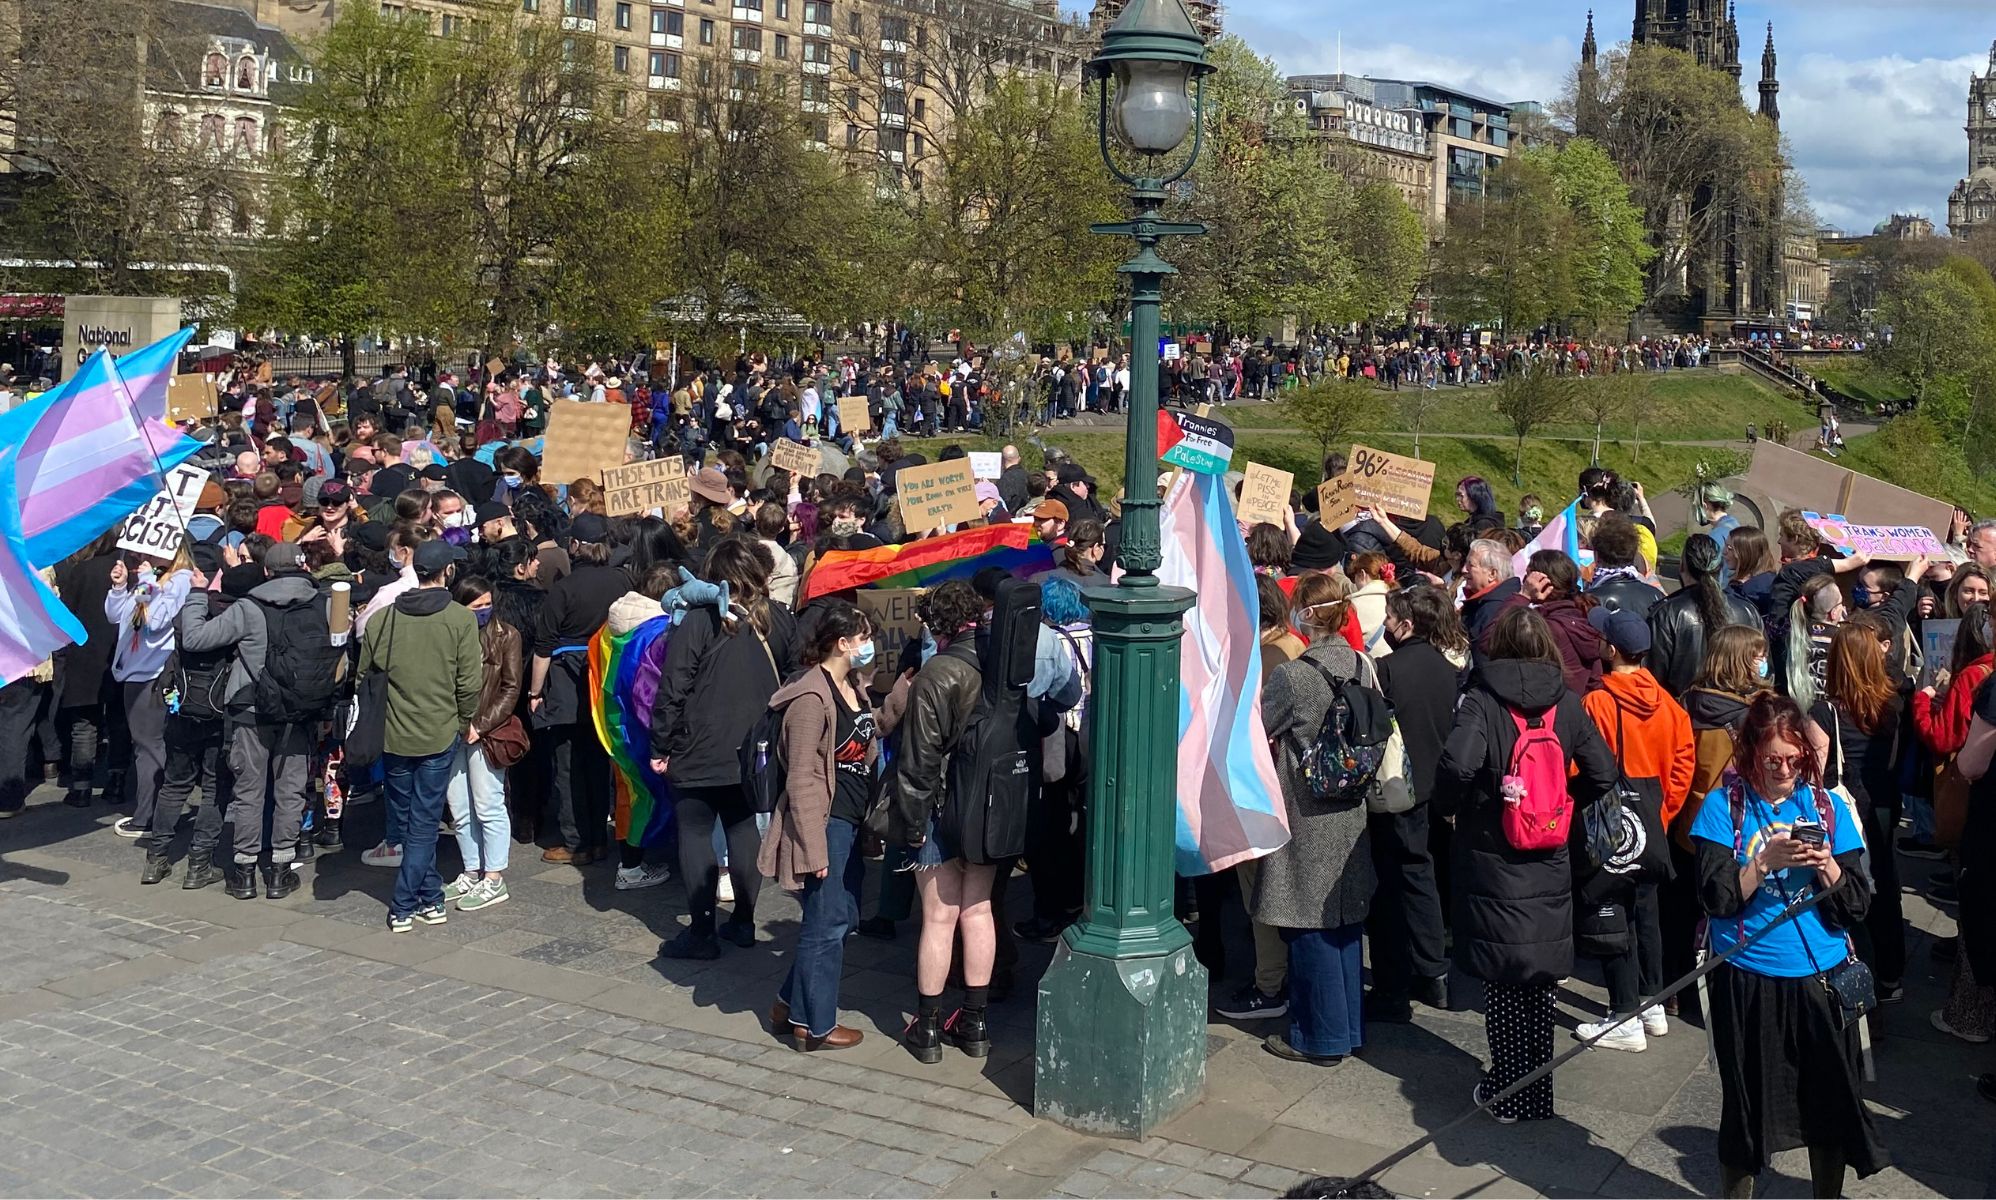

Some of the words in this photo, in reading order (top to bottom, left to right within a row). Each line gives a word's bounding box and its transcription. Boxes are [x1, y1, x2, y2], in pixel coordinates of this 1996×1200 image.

[78, 324, 133, 345] National
[1176, 412, 1218, 436] Trannies
[1196, 436, 1213, 447] Free
[605, 466, 646, 489] THESE
[646, 457, 683, 478] TITS
[1353, 449, 1390, 477] 96%
[903, 482, 919, 493] YOU
[921, 479, 934, 489] ARE
[938, 472, 965, 485] WORTH
[1255, 470, 1272, 483] LET
[611, 488, 642, 511] ARE
[642, 479, 690, 505] TRANS
[1257, 483, 1276, 496] PISS
[1844, 525, 1885, 538] TRANS
[1886, 527, 1932, 538] WOMEN
[1851, 537, 1942, 555] BELONG
